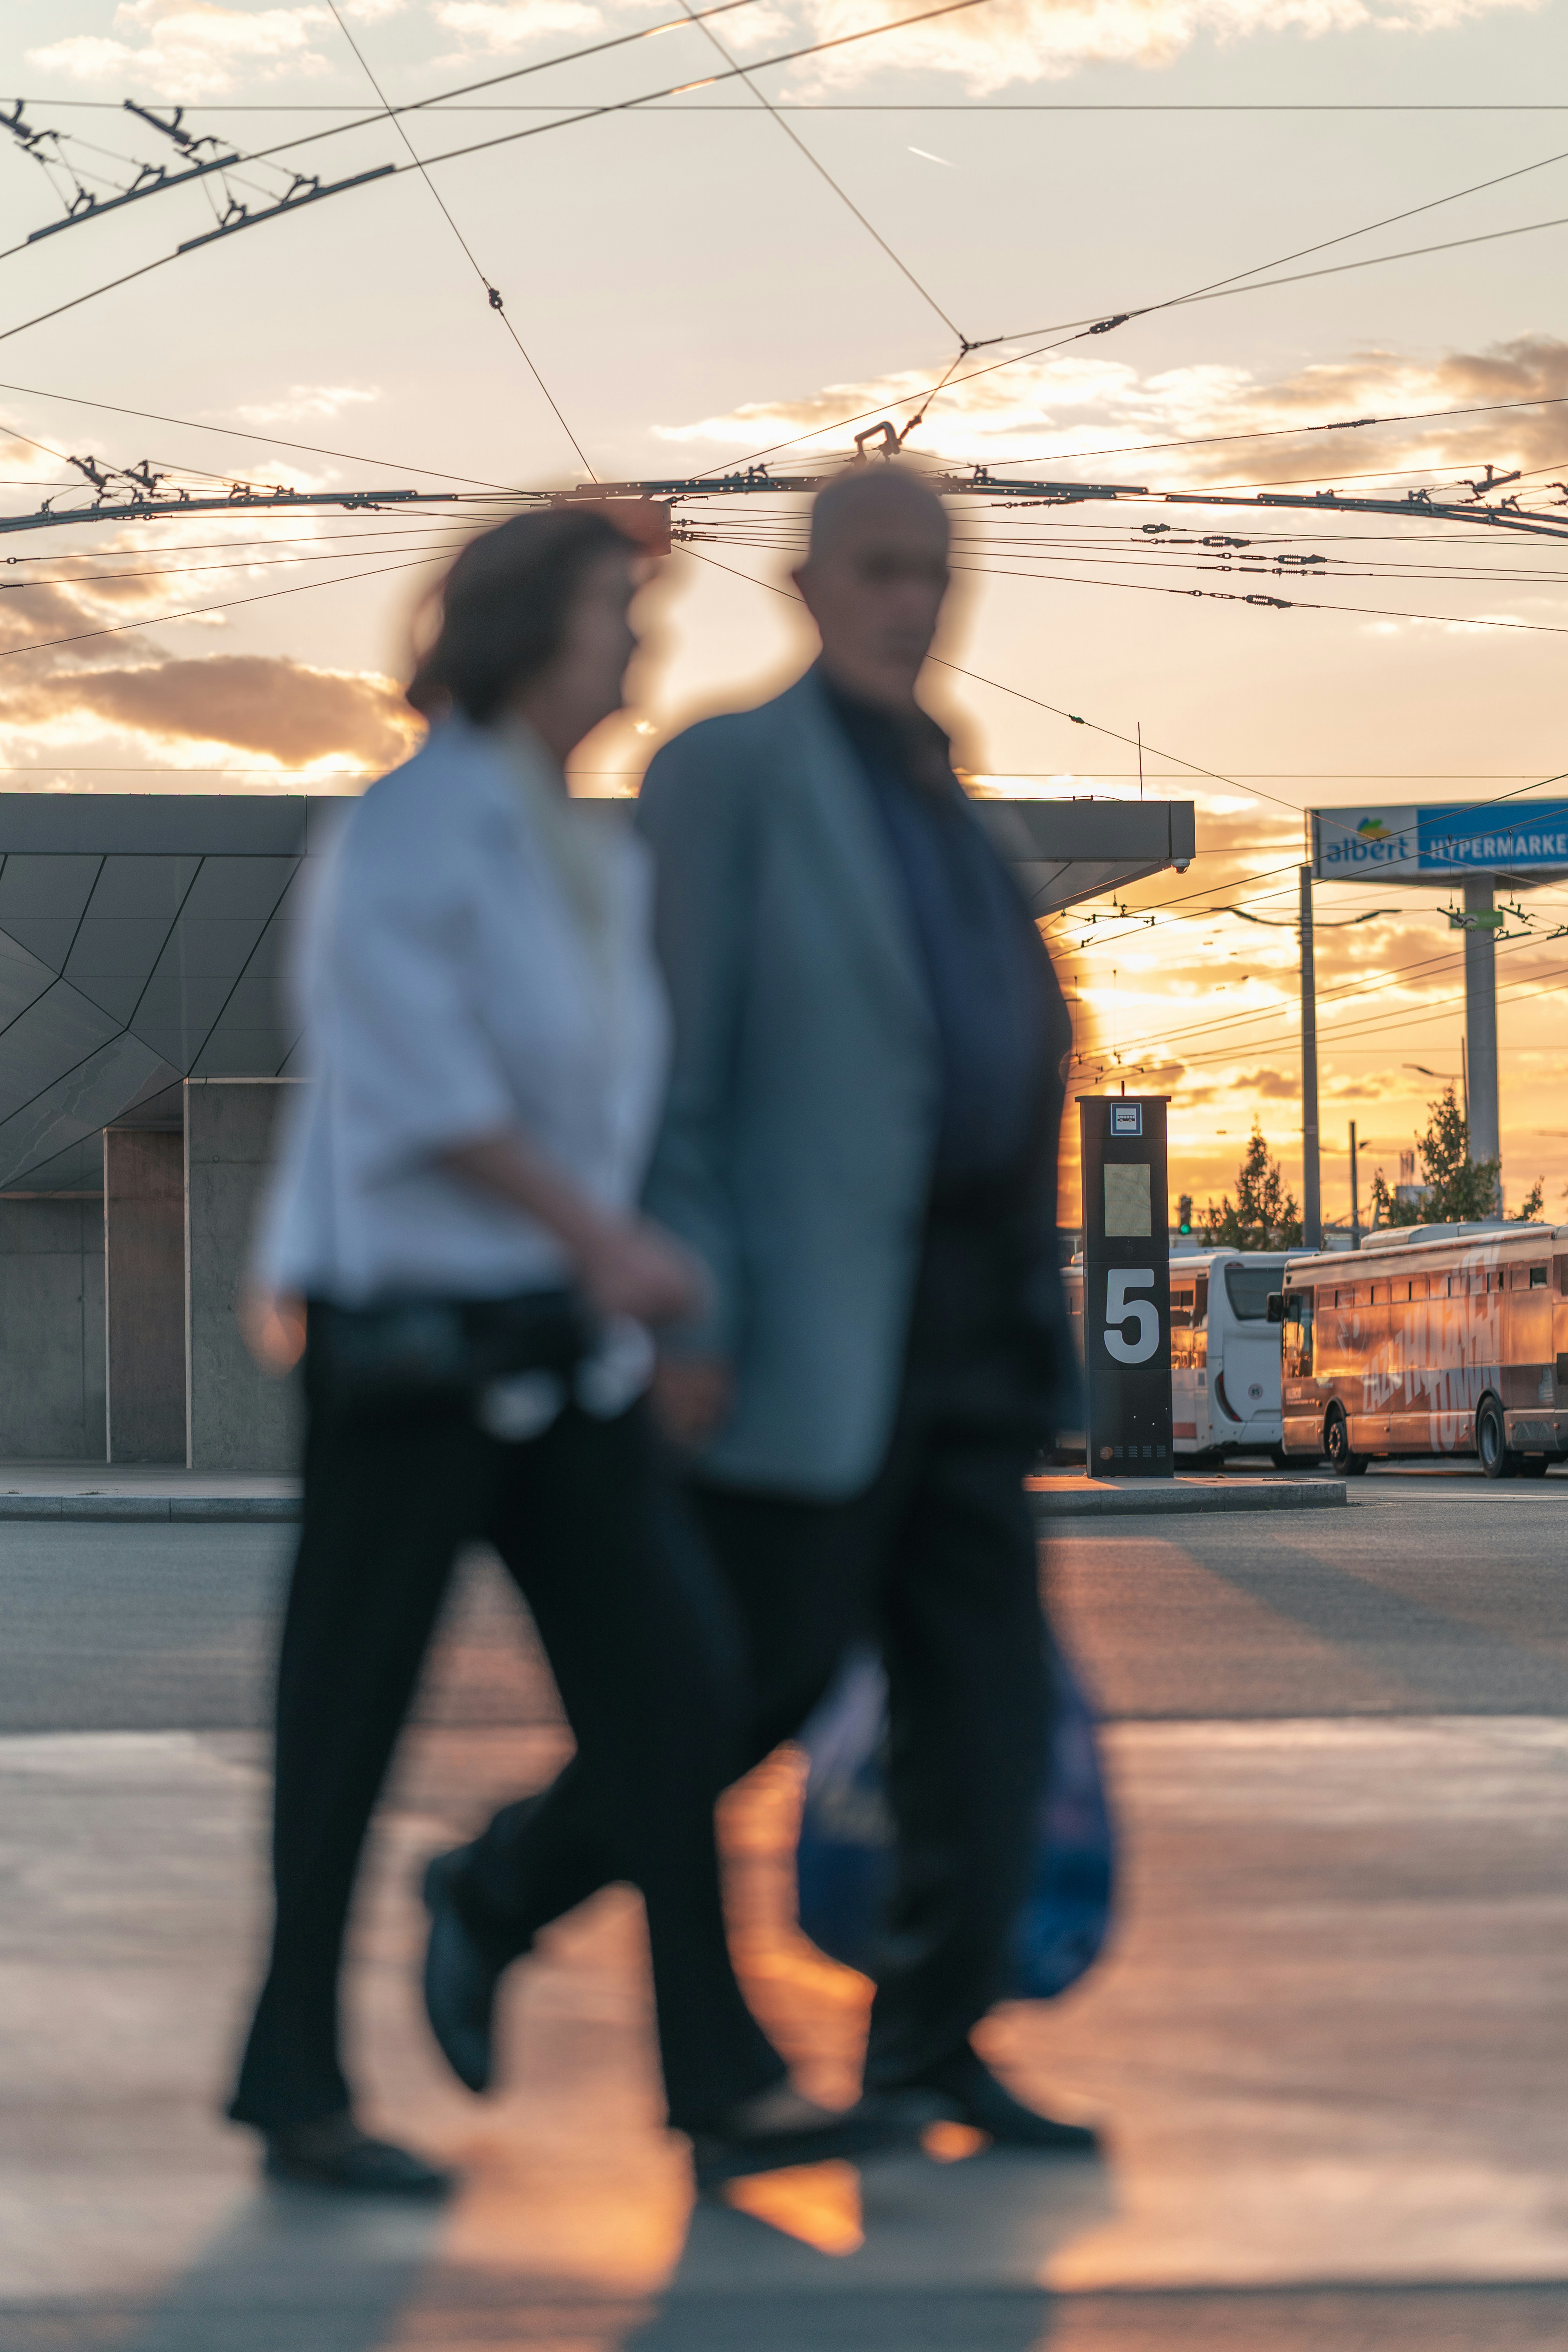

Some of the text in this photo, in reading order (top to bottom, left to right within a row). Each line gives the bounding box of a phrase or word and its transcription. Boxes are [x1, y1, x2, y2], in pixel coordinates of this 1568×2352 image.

[1327, 835, 1408, 862] albert
[1430, 833, 1568, 860] HYPERMARKE
[1103, 1269, 1159, 1363] 5
